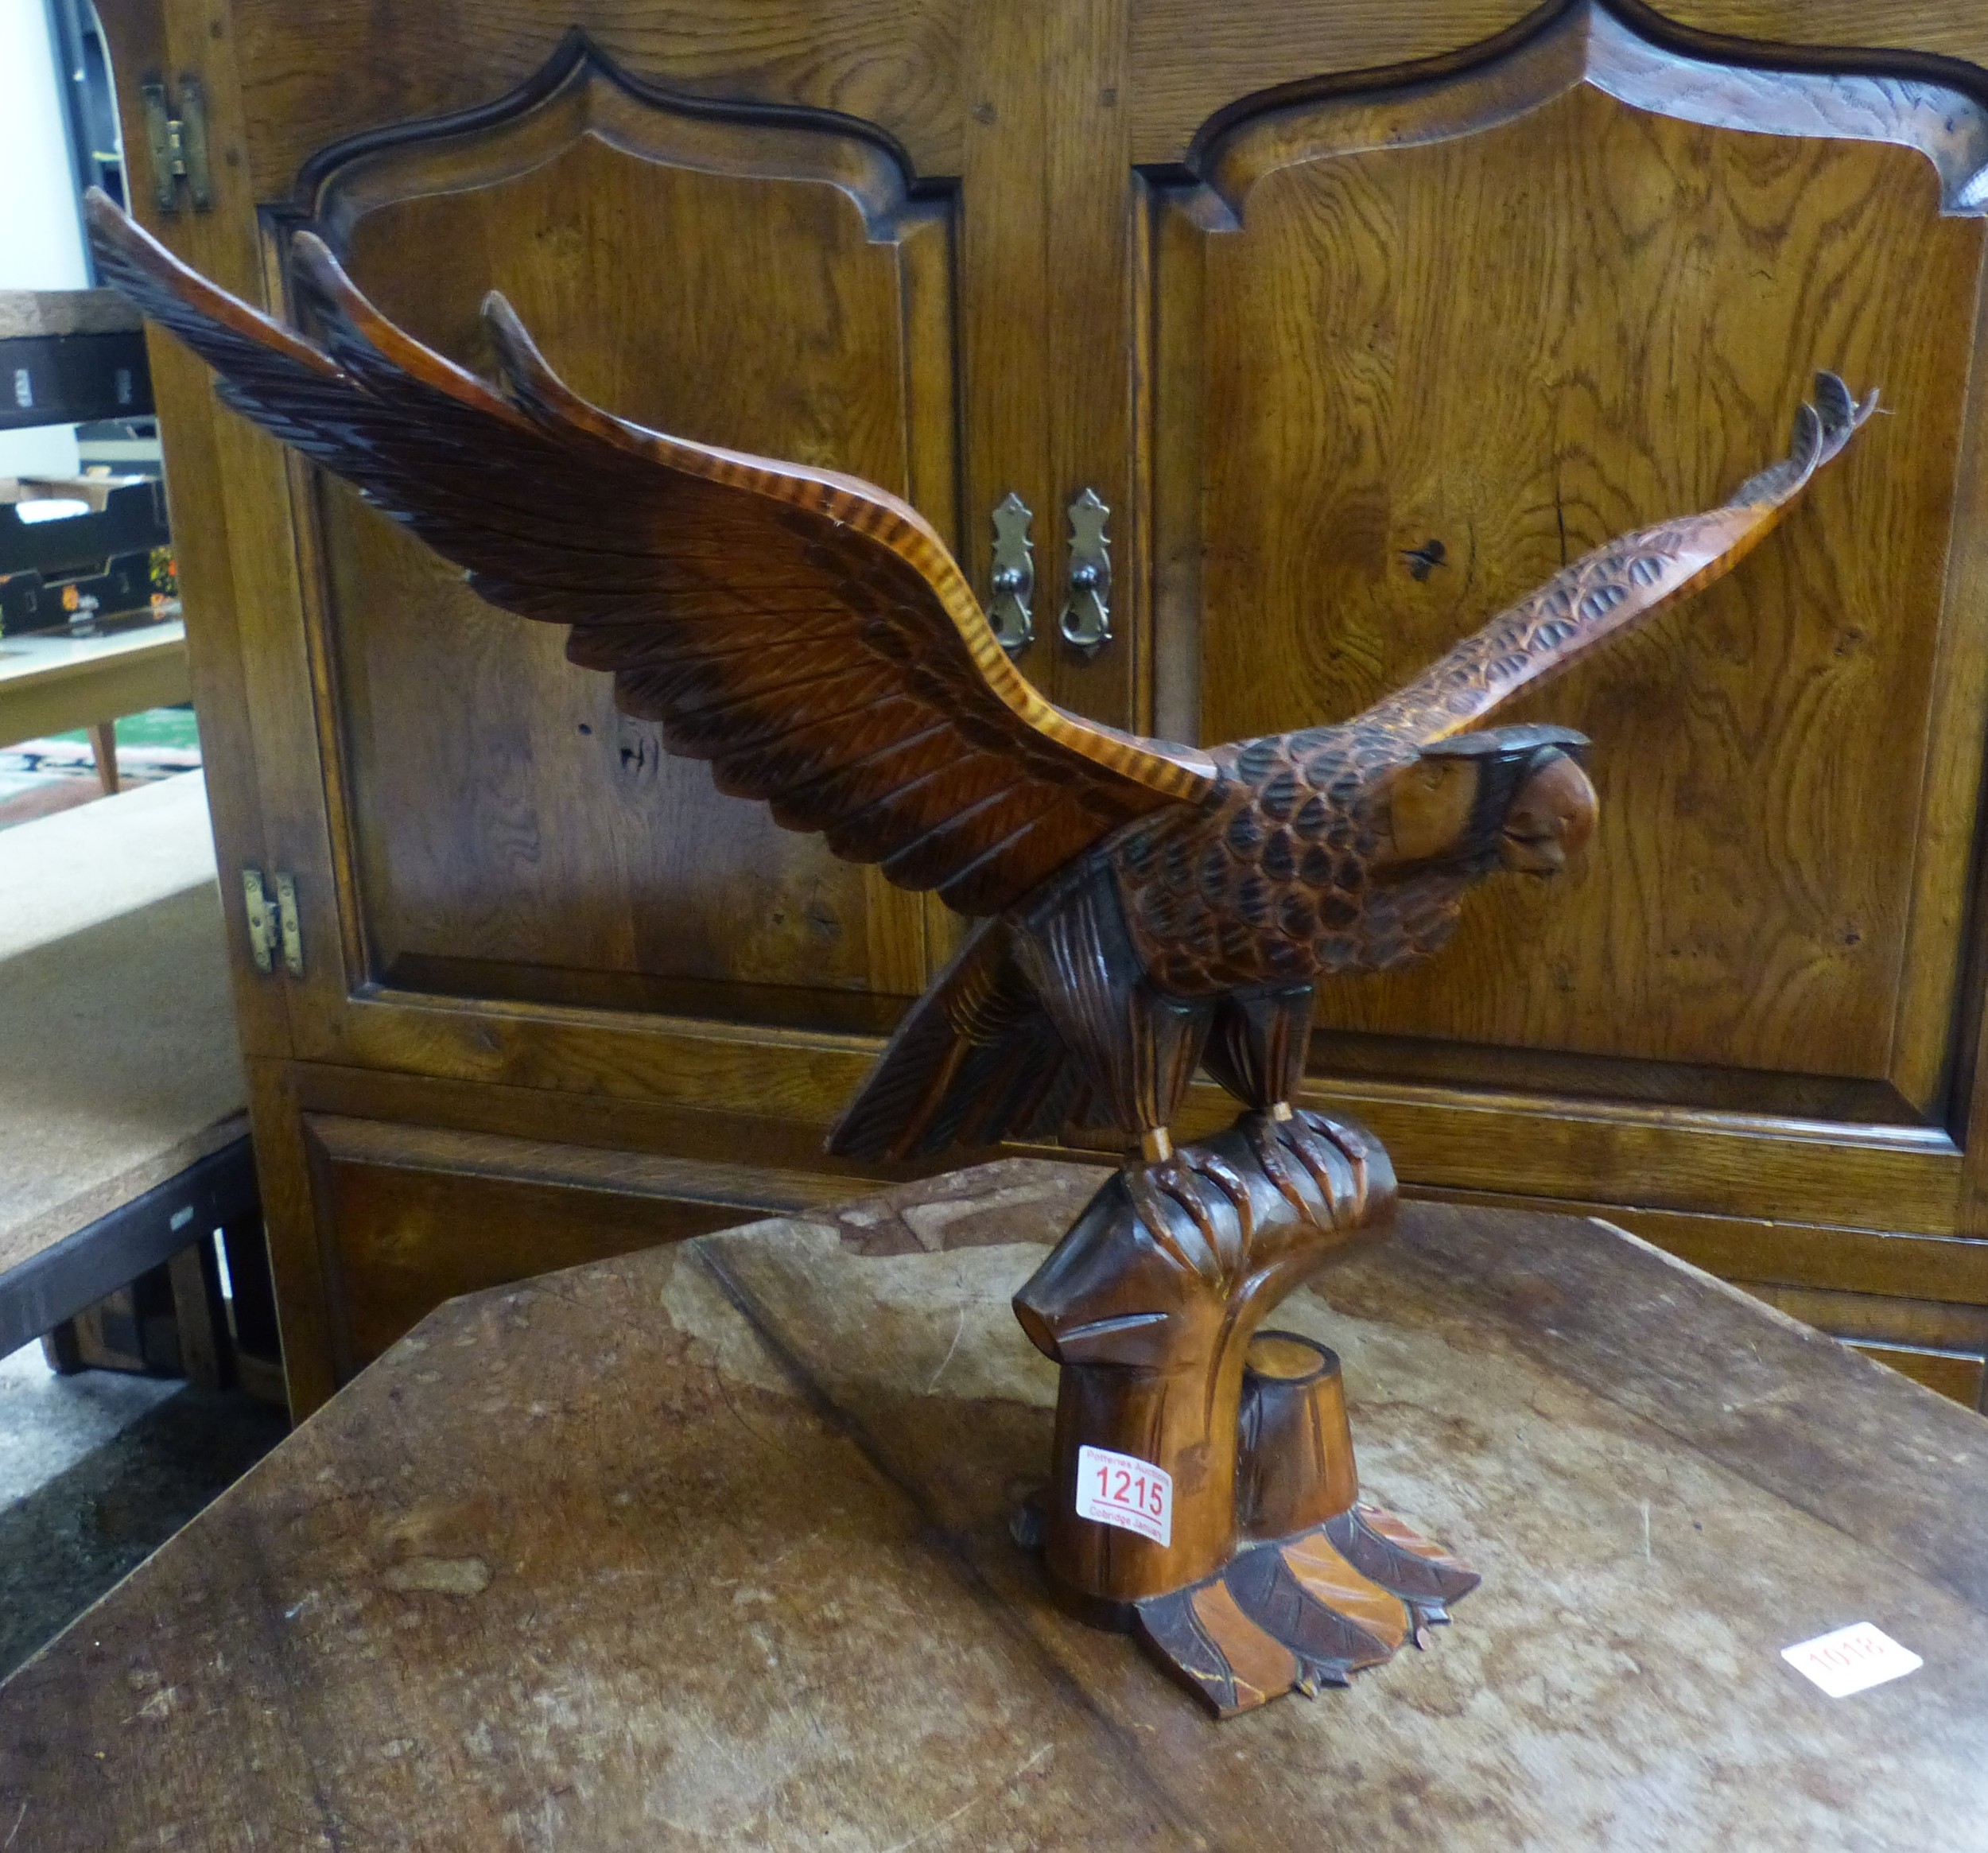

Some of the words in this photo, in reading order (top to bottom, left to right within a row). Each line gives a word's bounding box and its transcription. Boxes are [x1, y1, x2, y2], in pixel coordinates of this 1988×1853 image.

[1087, 1449, 1132, 1470] Potteries
[1097, 1466, 1163, 1516] 1215
[1089, 1505, 1132, 1526] Cobridge
[1132, 1518, 1163, 1541] January
